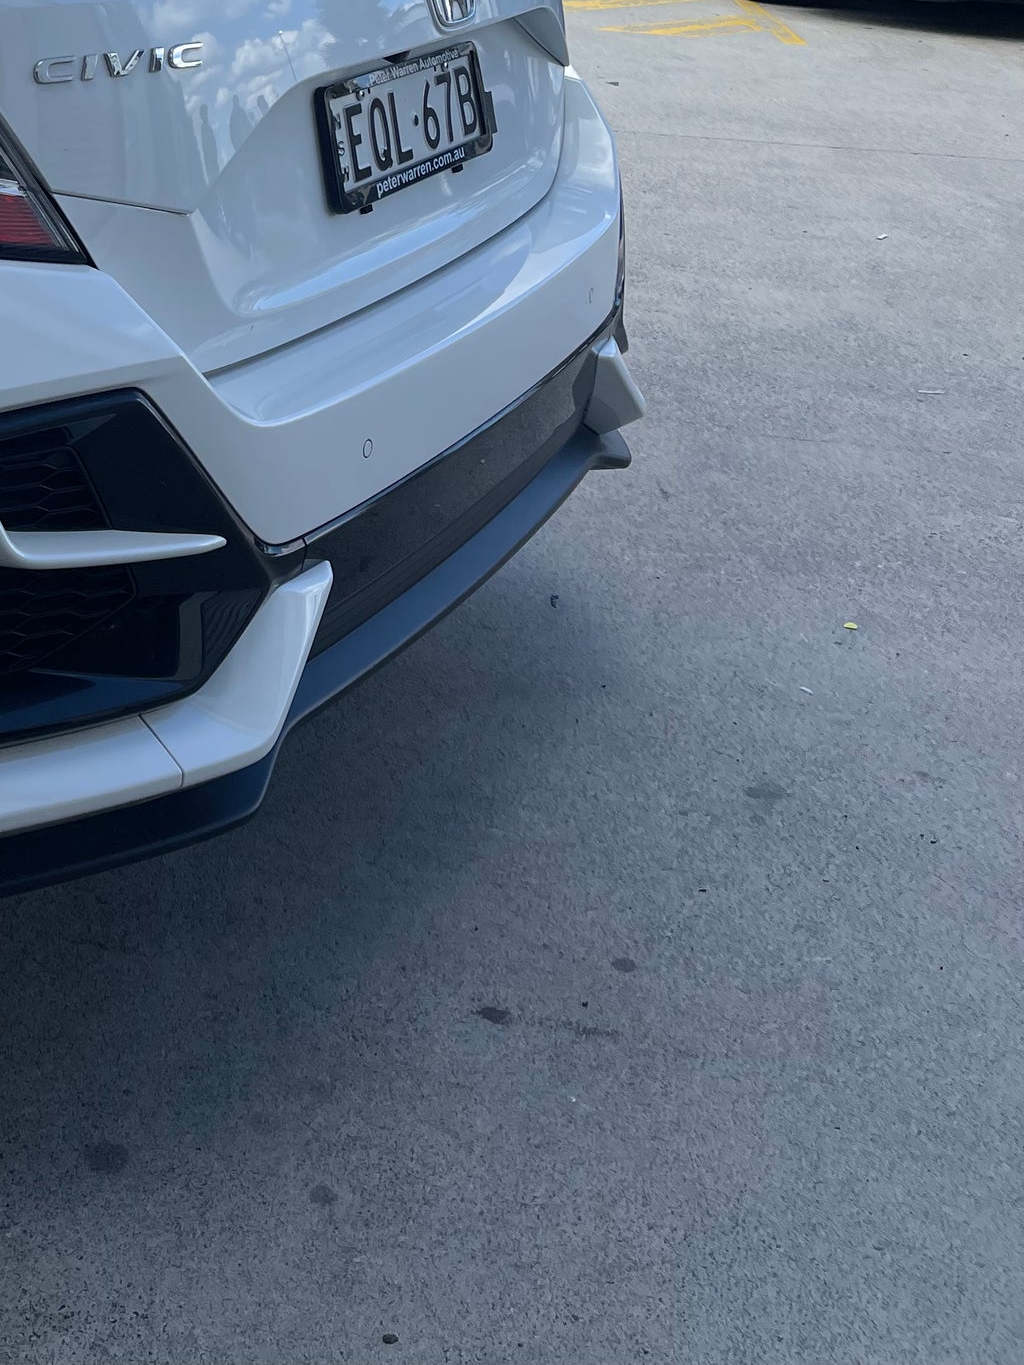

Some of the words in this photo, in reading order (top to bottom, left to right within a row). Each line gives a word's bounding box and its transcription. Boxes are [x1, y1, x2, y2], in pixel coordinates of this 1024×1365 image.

[33, 41, 204, 85] CIVIC
[368, 69, 390, 87] Peter
[390, 62, 419, 80] Warren
[419, 49, 459, 70] Automotive
[376, 147, 465, 199] peterwarren.com.au
